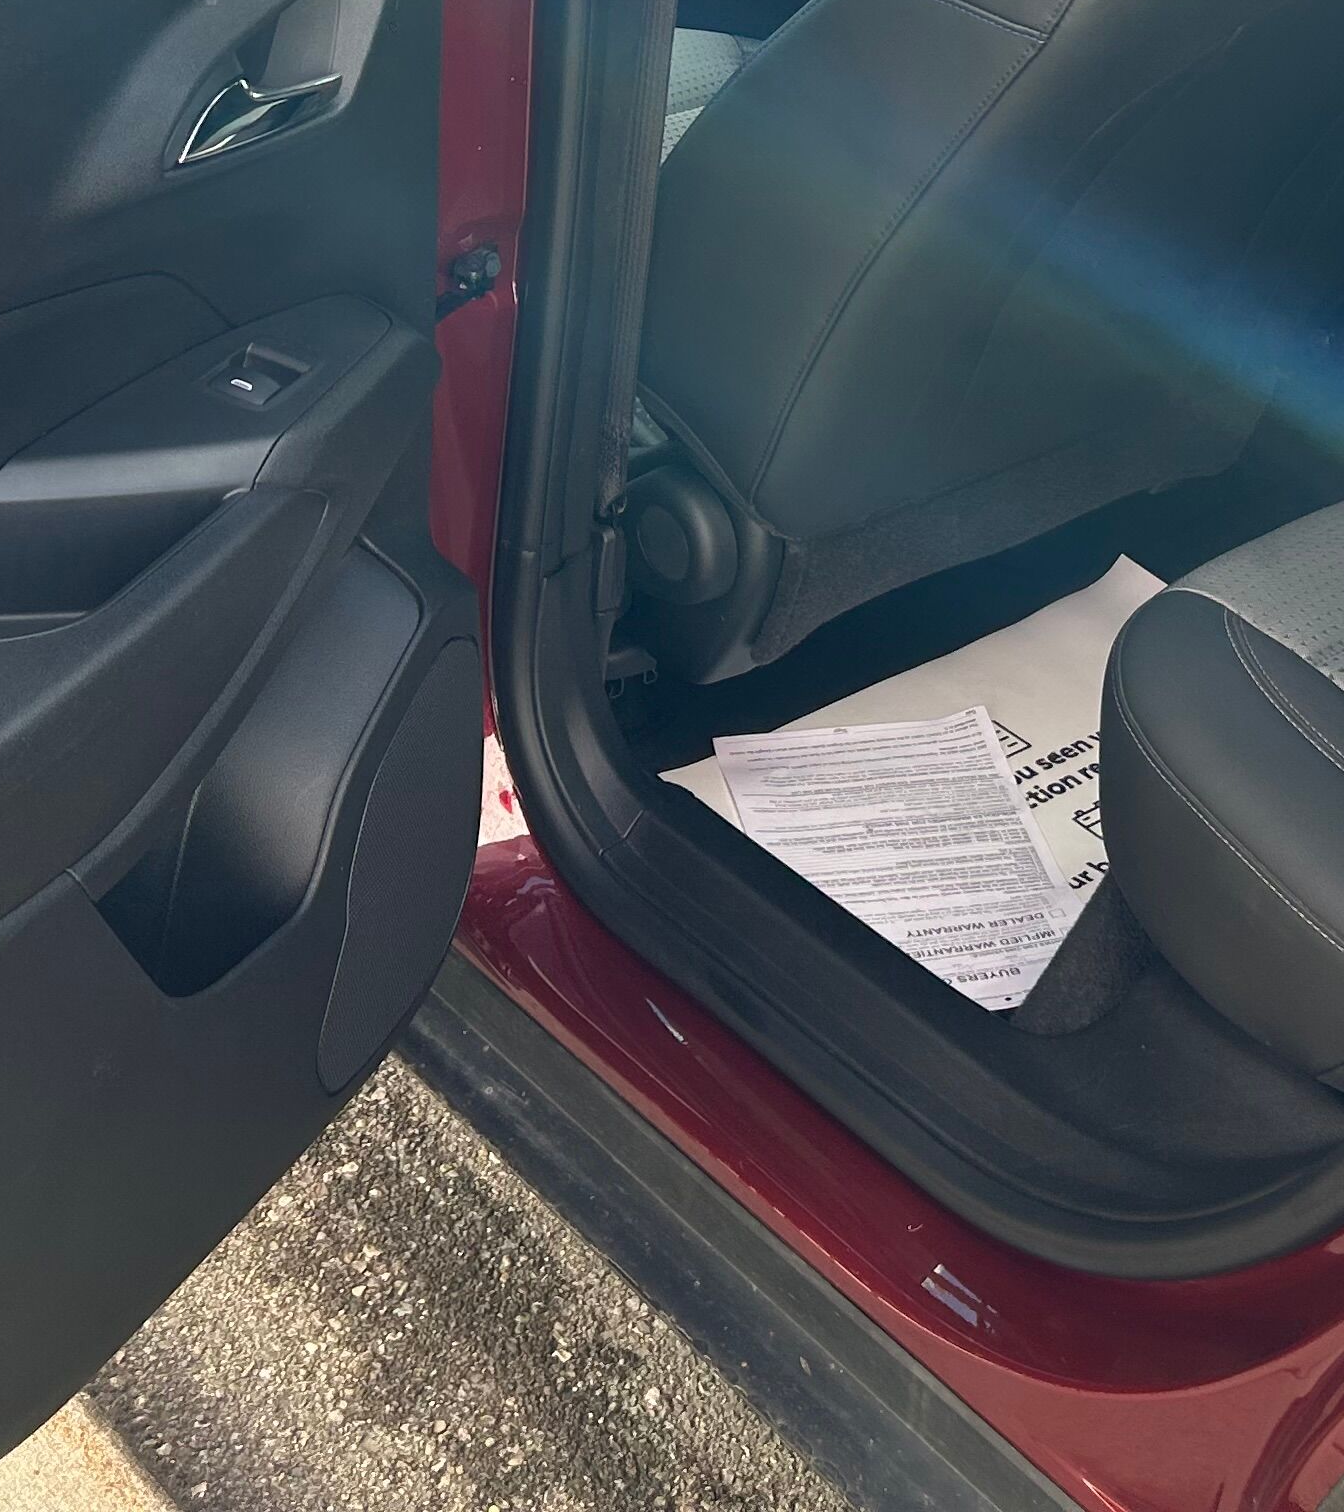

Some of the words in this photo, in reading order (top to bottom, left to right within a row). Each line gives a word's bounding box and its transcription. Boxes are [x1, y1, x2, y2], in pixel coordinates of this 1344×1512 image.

[1035, 740, 1094, 771] seen
[989, 912, 1045, 928] DEALER
[906, 922, 986, 938] WARRANTY
[999, 929, 1056, 945] IMPLIED
[956, 966, 1022, 984] BUYERS
